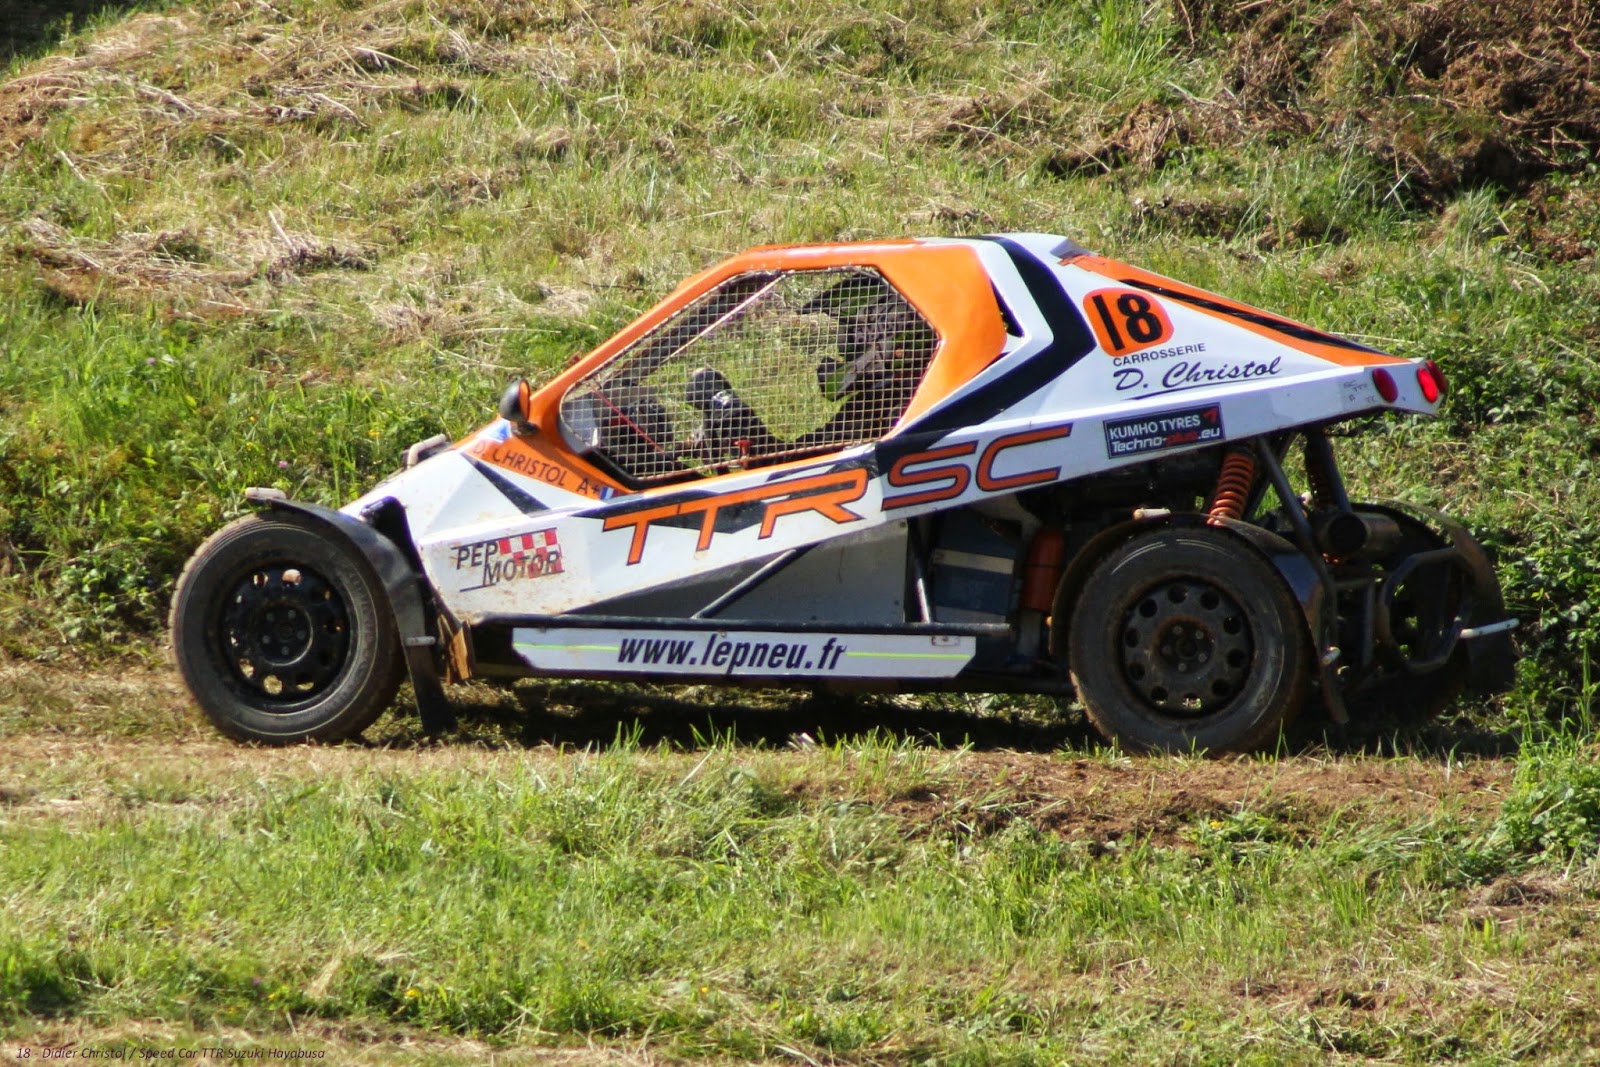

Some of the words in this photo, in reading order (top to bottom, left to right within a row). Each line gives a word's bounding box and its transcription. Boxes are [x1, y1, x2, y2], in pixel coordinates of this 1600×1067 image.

[1092, 294, 1163, 351] 18
[1113, 343, 1206, 367] CARROSSERIE
[1113, 367, 1148, 391] D.
[1162, 356, 1282, 389] Christol
[1109, 422, 1158, 440] KUMHO
[1160, 414, 1201, 432] TYRES
[492, 448, 567, 487] CHRISTOL
[456, 541, 498, 570] PEP
[483, 550, 562, 586] MOTOR
[618, 632, 848, 674] www.lepneu.fr
